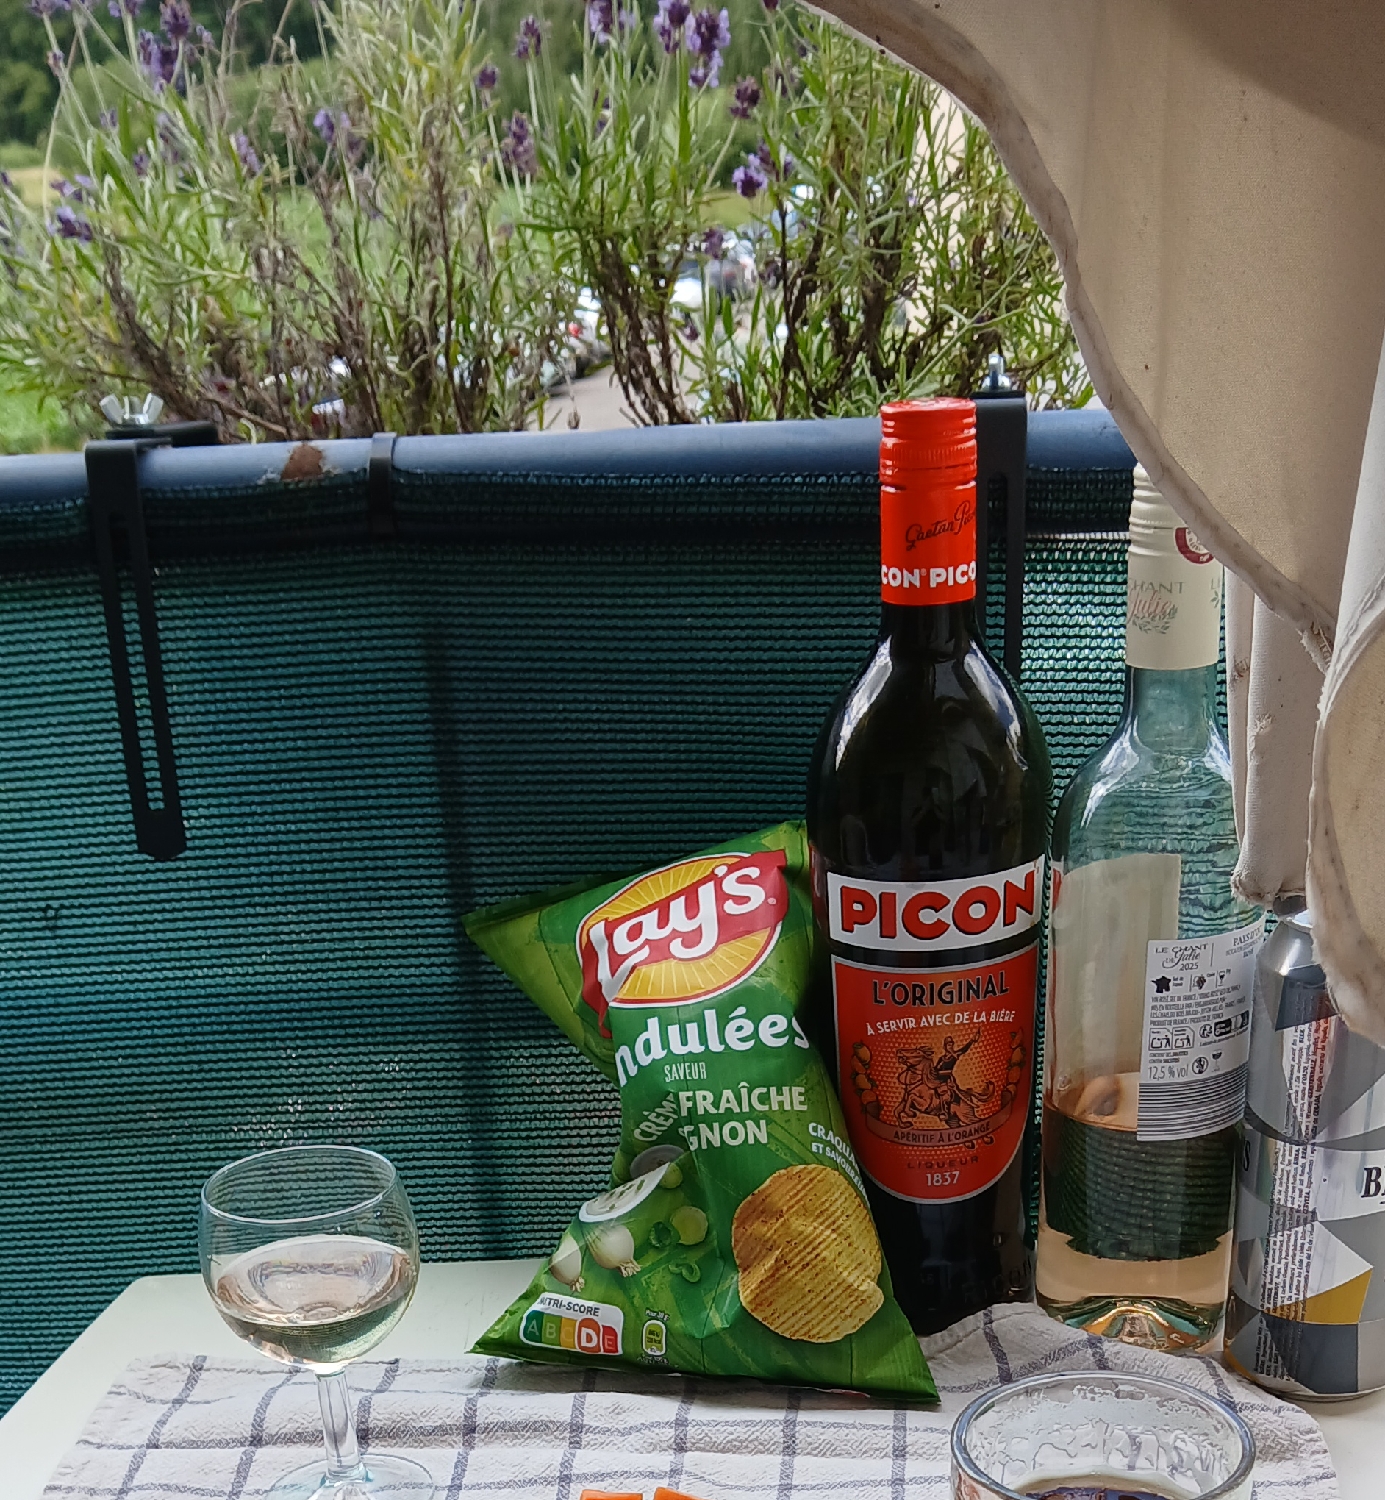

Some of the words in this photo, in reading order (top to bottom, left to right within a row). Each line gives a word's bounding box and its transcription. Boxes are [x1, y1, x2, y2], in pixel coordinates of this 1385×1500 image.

[1130, 579, 1185, 594] HANT
[840, 870, 1035, 940] PICON
[589, 864, 766, 1002] Lay's
[1179, 962, 1199, 971] 2025
[873, 971, 1010, 1007] L'ORIGINAL
[866, 1022, 875, 1036] À
[876, 1016, 916, 1034] SERVIR
[919, 1013, 951, 1028] AVEC
[954, 1011, 972, 1024] DE
[973, 1010, 987, 1023] LA
[664, 1062, 707, 1083] SAVEUR
[1148, 1065, 1166, 1081] 12,5
[1177, 1063, 1189, 1078] vol
[633, 1092, 679, 1142] CRÈM
[678, 1081, 808, 1117] FRAÎCHE
[947, 1121, 991, 1143] L'ORANGE
[811, 1142, 824, 1154] ET
[907, 1155, 979, 1170] LIQUEUR
[926, 1171, 960, 1187] 1837
[537, 1296, 601, 1317] TRI-SCORE
[527, 1319, 540, 1336] A
[546, 1322, 557, 1338] B
[562, 1327, 573, 1341] C
[581, 1327, 598, 1347] D
[604, 1335, 614, 1349] E
